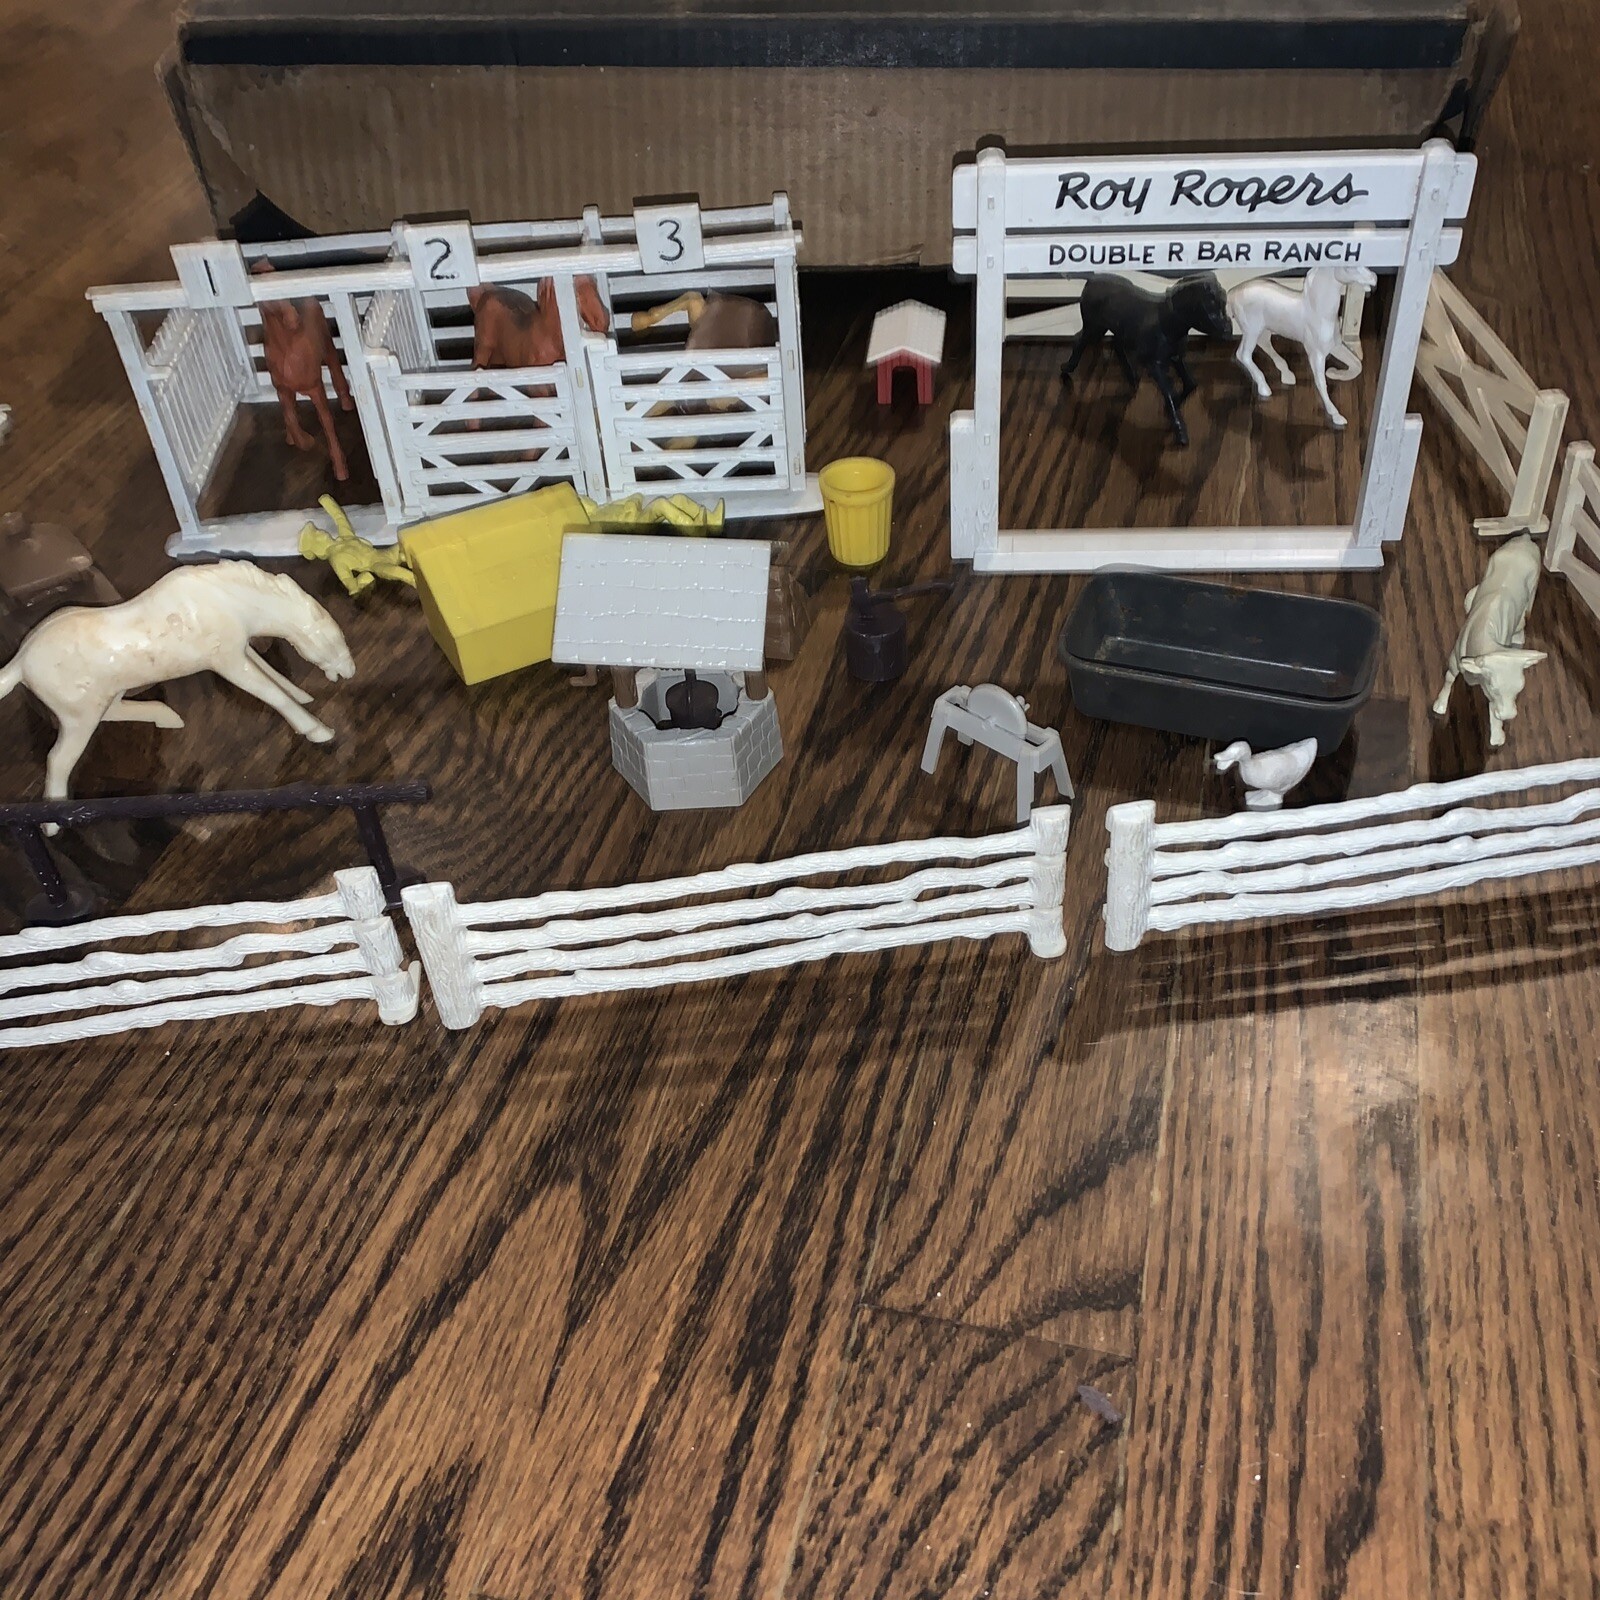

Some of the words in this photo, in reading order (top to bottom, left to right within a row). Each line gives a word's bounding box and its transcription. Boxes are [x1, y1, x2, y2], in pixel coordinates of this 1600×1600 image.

[1055, 172, 1152, 215] Roy
[1170, 169, 1369, 213] Rogers
[424, 238, 456, 280] 2
[658, 219, 685, 262] 3
[1049, 243, 1155, 265] DOUBLE
[1168, 241, 1183, 262] R
[1198, 241, 1251, 262] BAR
[1264, 240, 1361, 263] RANCH
[203, 258, 217, 296] 1
